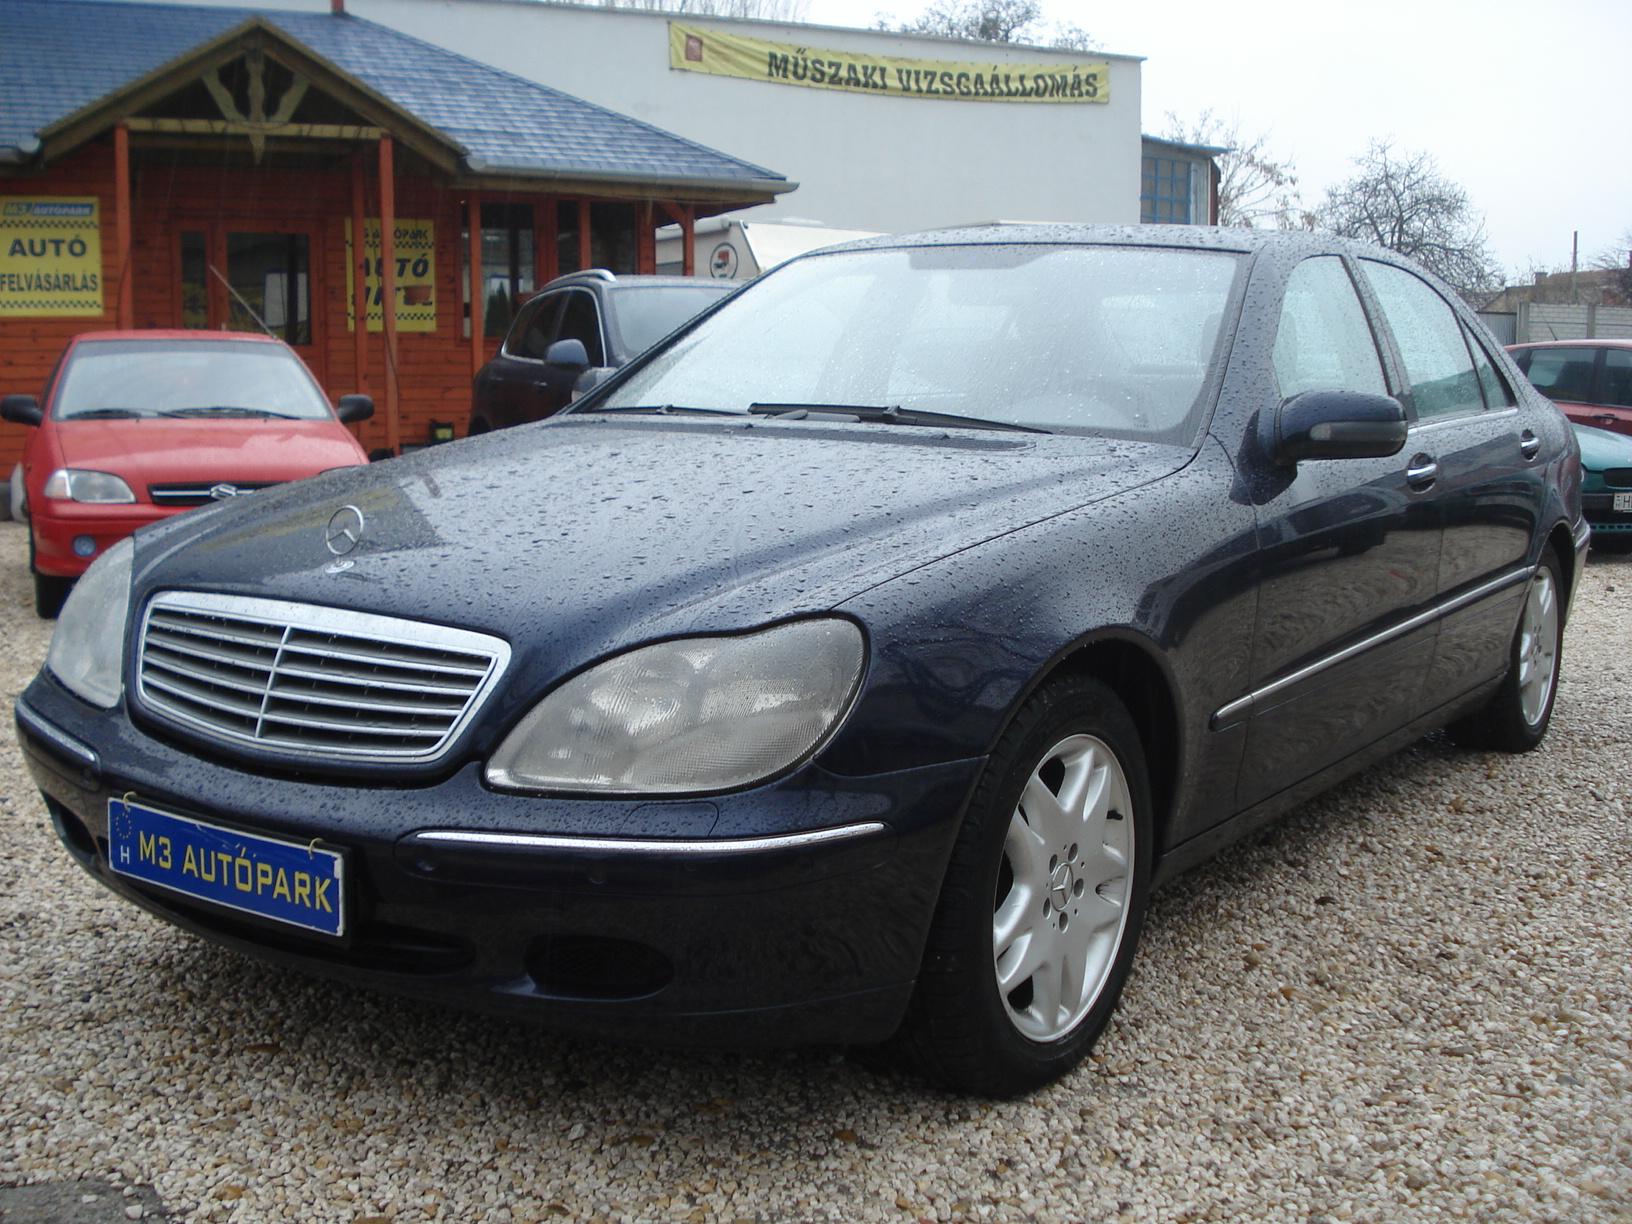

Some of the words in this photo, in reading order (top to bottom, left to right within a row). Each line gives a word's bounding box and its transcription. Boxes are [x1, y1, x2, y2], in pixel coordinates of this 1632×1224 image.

[767, 47, 888, 90] MŰSZAKI
[896, 65, 1099, 98] VIZSGAÁLLOMÁS
[8, 234, 87, 257] AUTÓ
[0, 268, 98, 292] FELVÁSÁRLÁS
[119, 845, 130, 865] H
[138, 830, 172, 870] M3
[181, 846, 333, 914] AUTÓPARK
